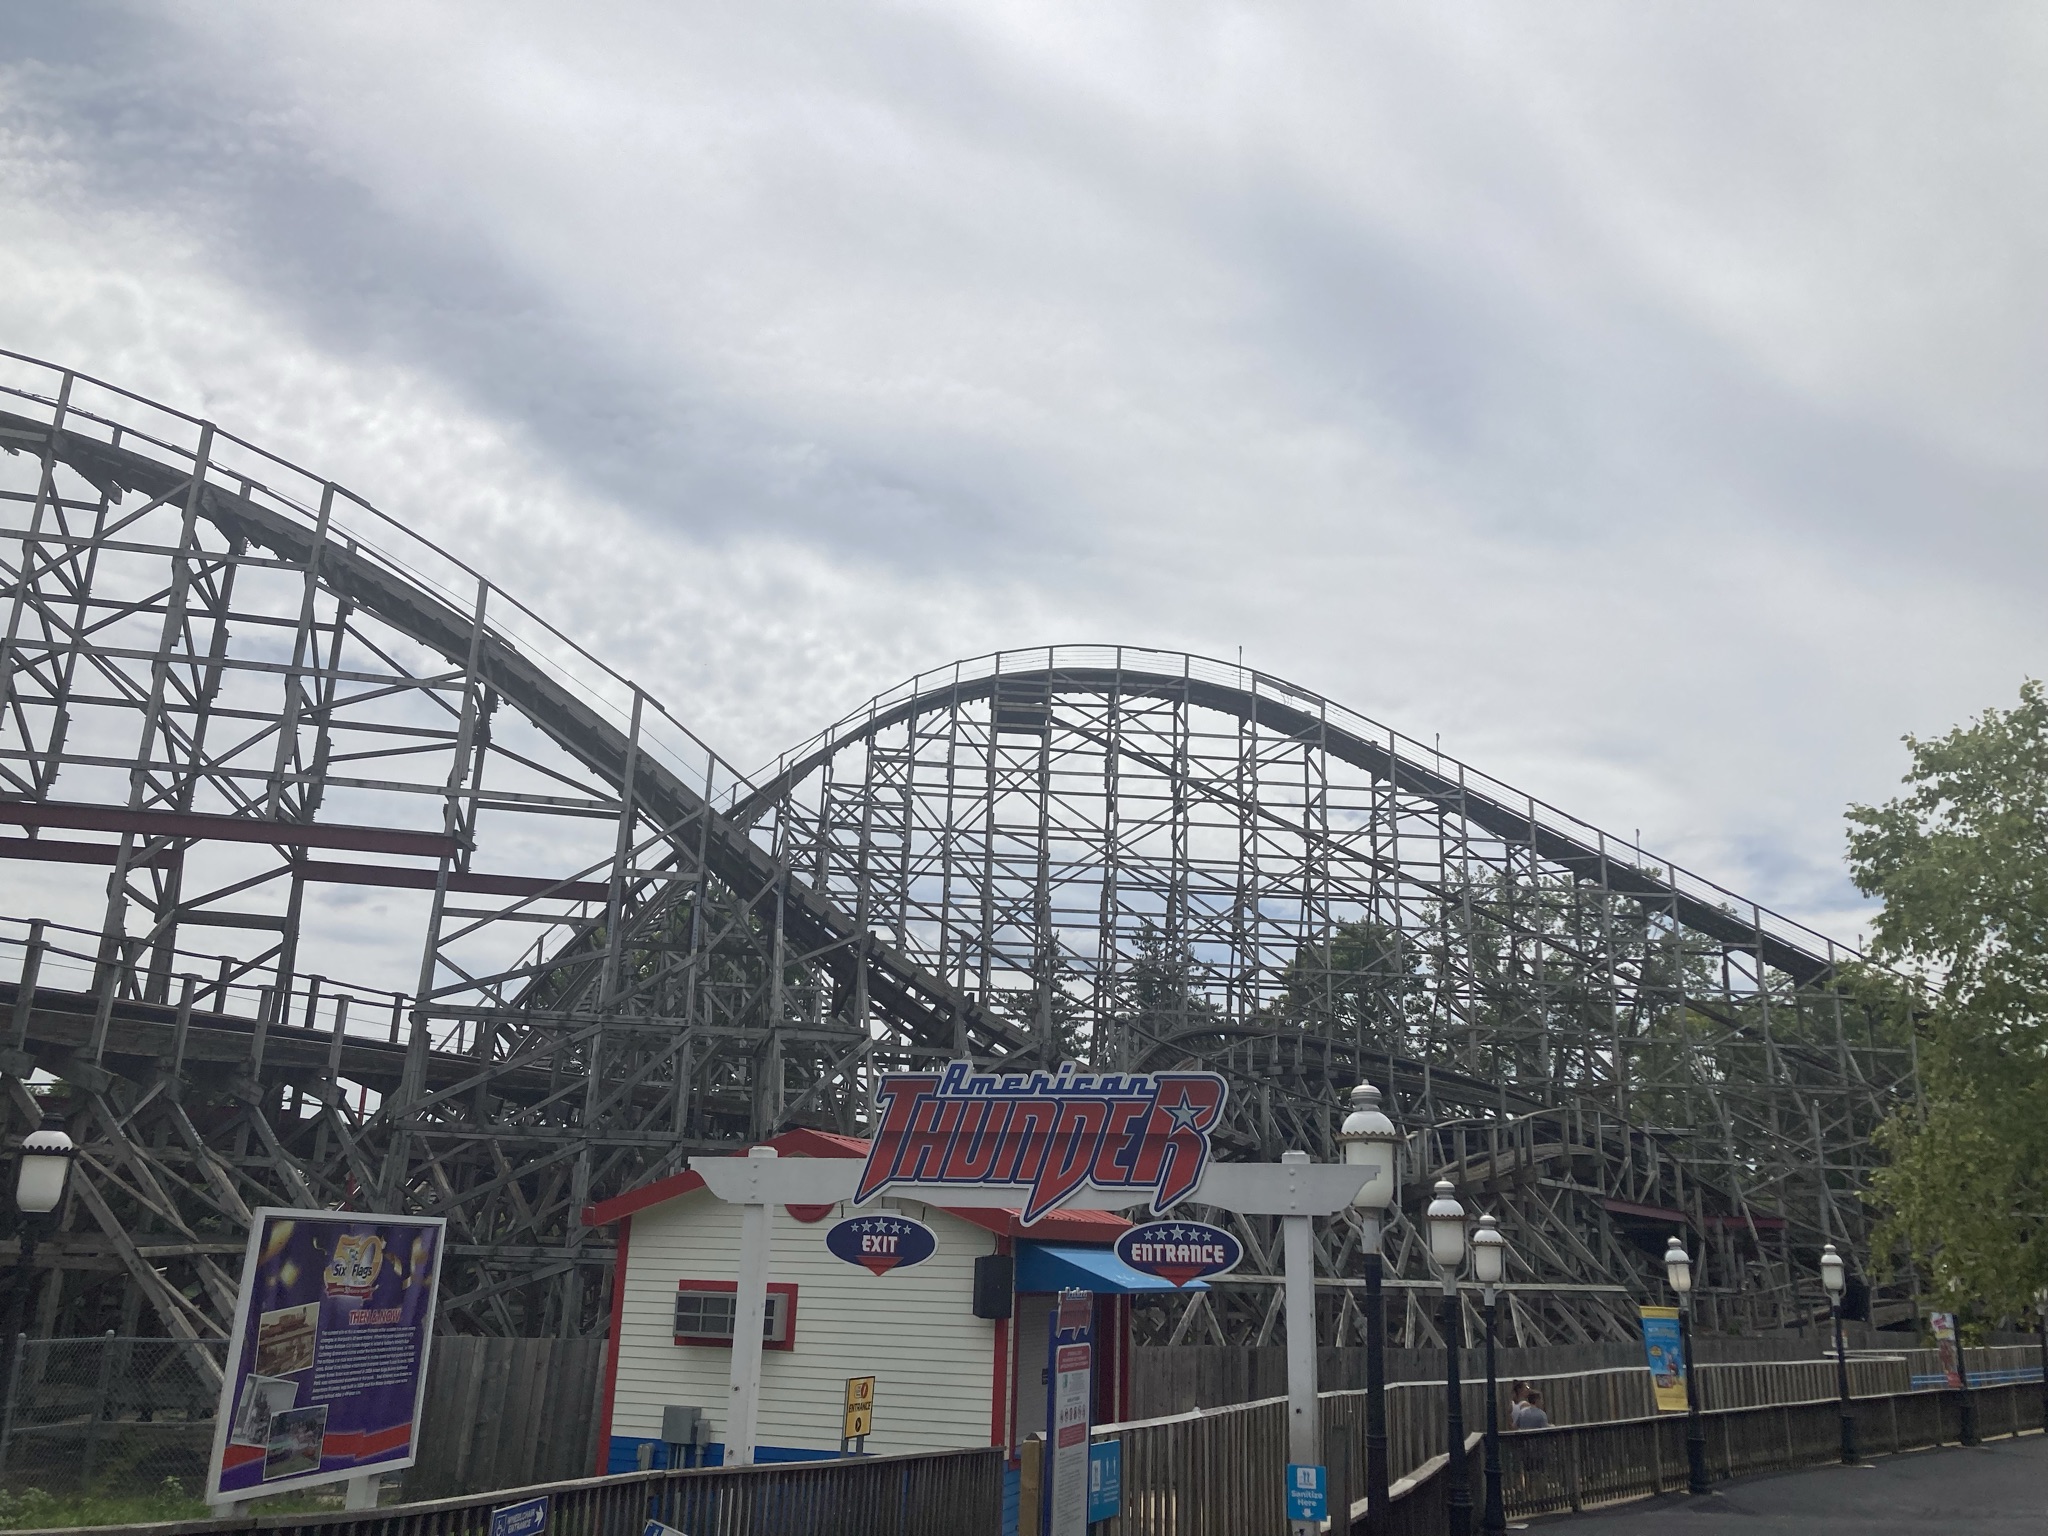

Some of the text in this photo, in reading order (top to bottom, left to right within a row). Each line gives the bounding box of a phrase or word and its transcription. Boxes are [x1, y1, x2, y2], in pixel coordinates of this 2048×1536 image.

[941, 1063, 1157, 1096] American
[855, 1075, 1225, 1223] THUNDER
[862, 1234, 898, 1253] EXIT
[1131, 1243, 1225, 1263] ENTRANCE
[333, 1264, 373, 1279] Six Flags
[349, 1309, 370, 1325] THEN
[380, 1308, 402, 1324] NOW
[848, 1402, 872, 1413] ENTRANCE
[1291, 1490, 1323, 1499] Sanitize
[1297, 1499, 1317, 1507] Here
[507, 1509, 535, 1524] WHEELCHAIR
[507, 1519, 531, 1534] ENTRANCE
